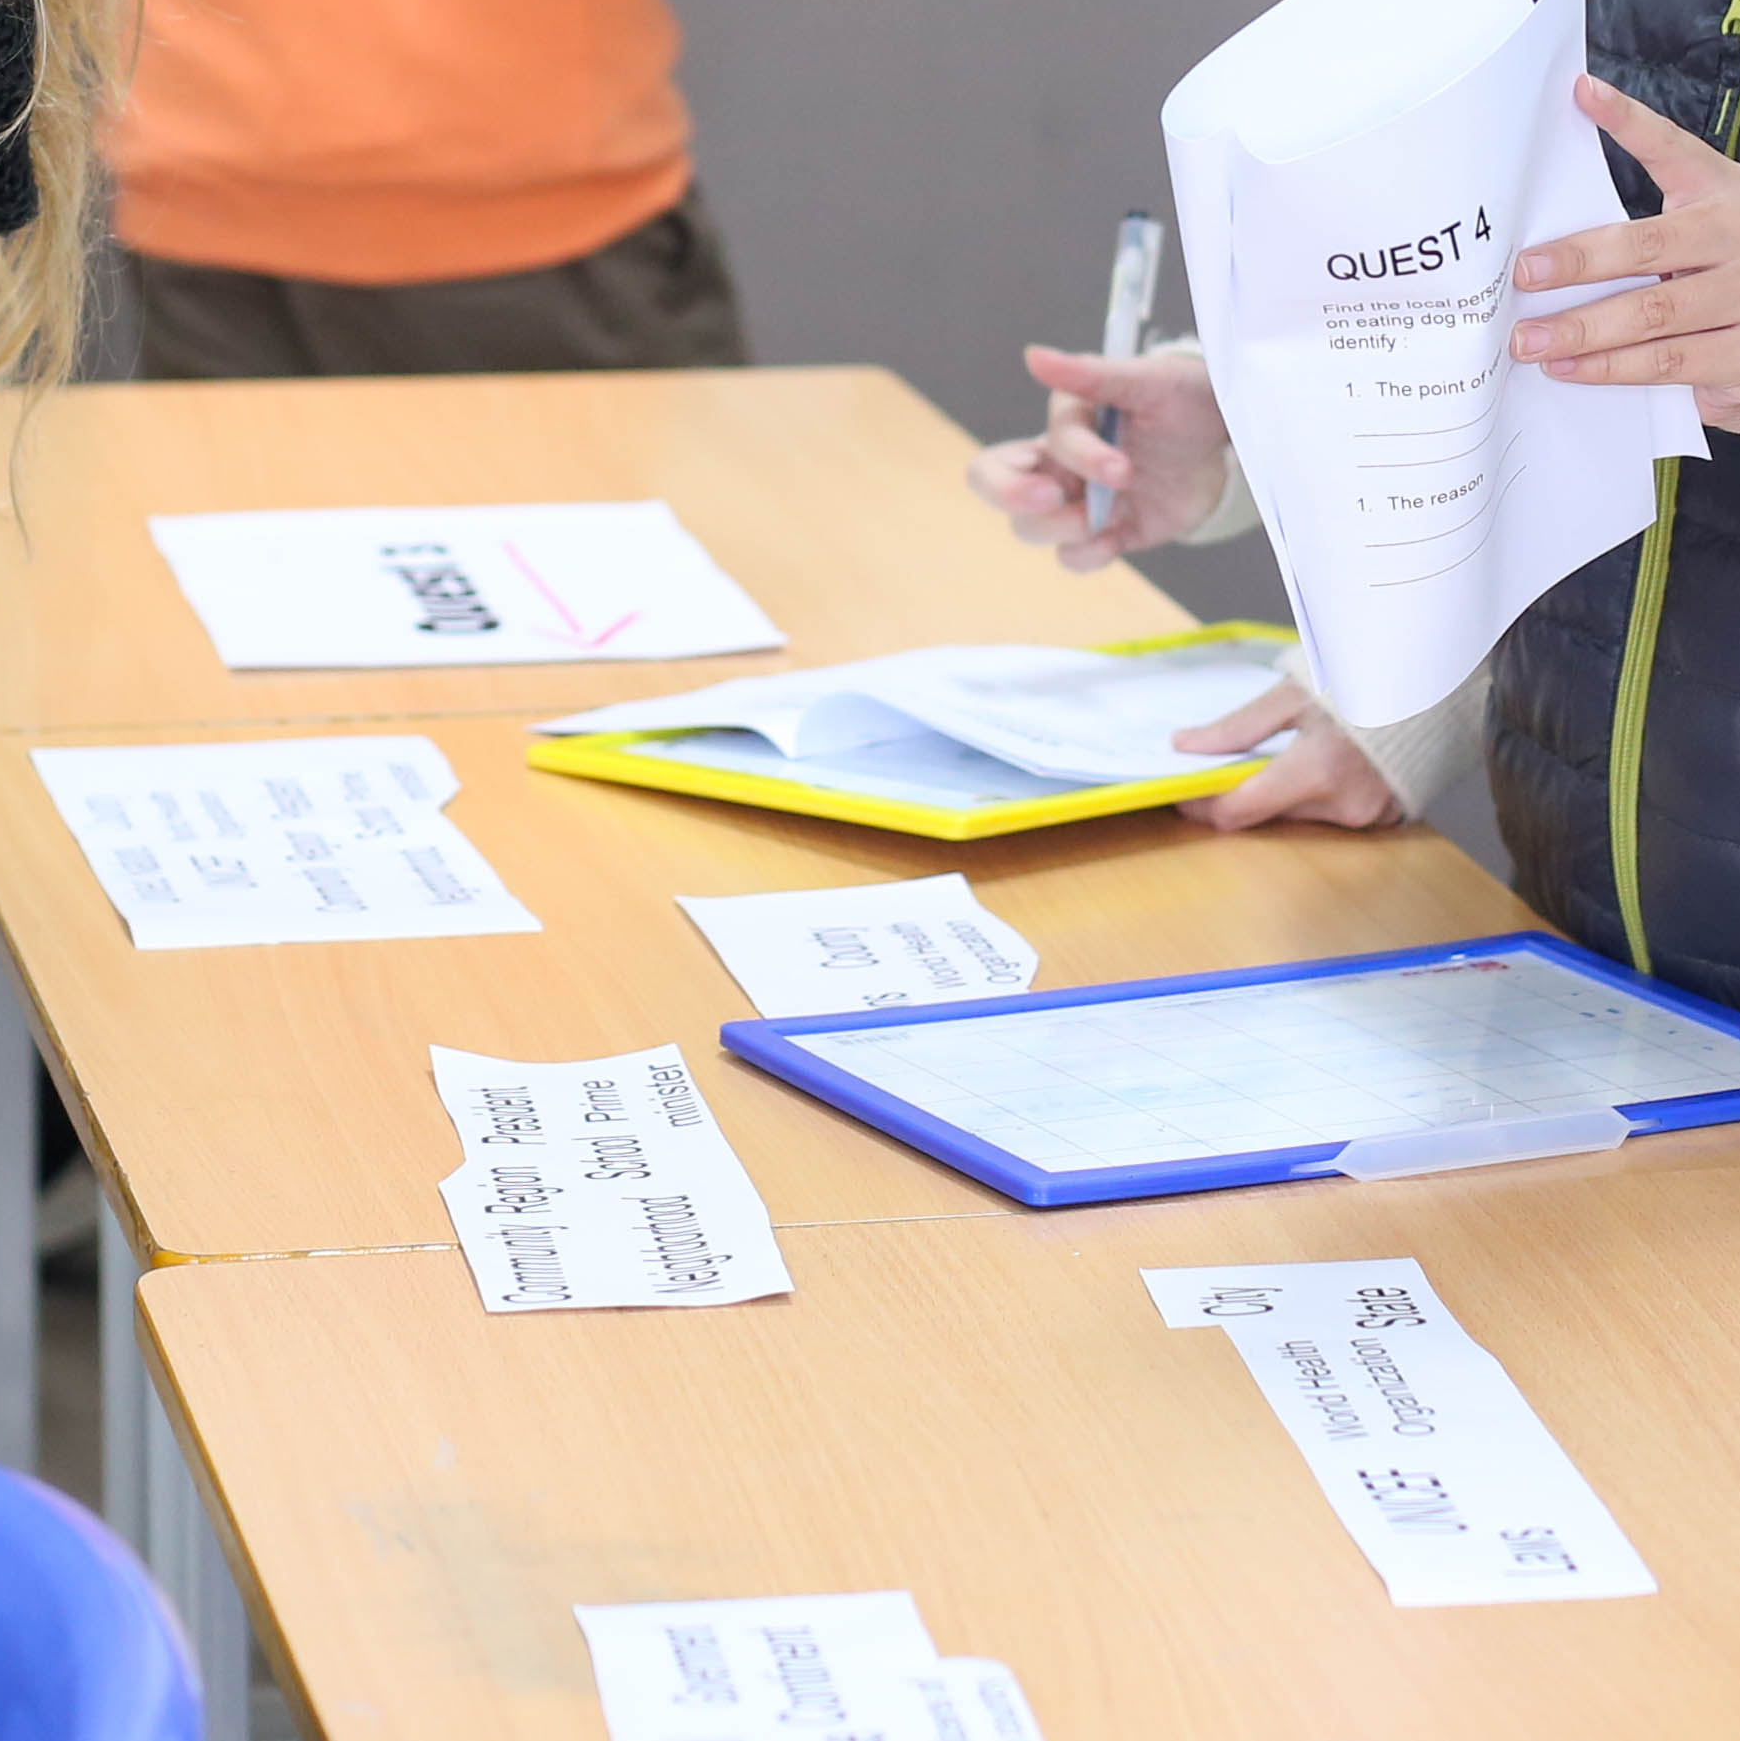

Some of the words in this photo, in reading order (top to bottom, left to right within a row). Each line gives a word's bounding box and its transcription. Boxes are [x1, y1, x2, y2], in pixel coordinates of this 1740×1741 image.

[1326, 221, 1464, 280] QUEST
[1474, 205, 1492, 243] 4
[1323, 302, 1364, 314] Find
[1370, 300, 1400, 311] the
[1406, 298, 1451, 310] local
[1326, 318, 1349, 329] on
[1356, 313, 1414, 329] eating
[1421, 312, 1455, 329] dog
[1329, 334, 1396, 352] identify
[1376, 382, 1412, 397] The
[1419, 380, 1465, 400] point
[1471, 369, 1487, 389] of
[1387, 495, 1425, 511] The
[1430, 473, 1484, 507] reason
[469, 1086, 546, 1145] President
[580, 1079, 628, 1123] Prime
[646, 1064, 703, 1128] minister
[571, 1135, 651, 1180] School
[478, 1166, 564, 1214] Region
[485, 1224, 572, 1304] Community
[621, 1195, 733, 1294] Neighborhood
[1199, 1286, 1283, 1317] City
[1347, 1286, 1427, 1329] State
[1277, 1339, 1341, 1390] Health
[1349, 1337, 1435, 1438] Organization
[1305, 1394, 1369, 1442] World
